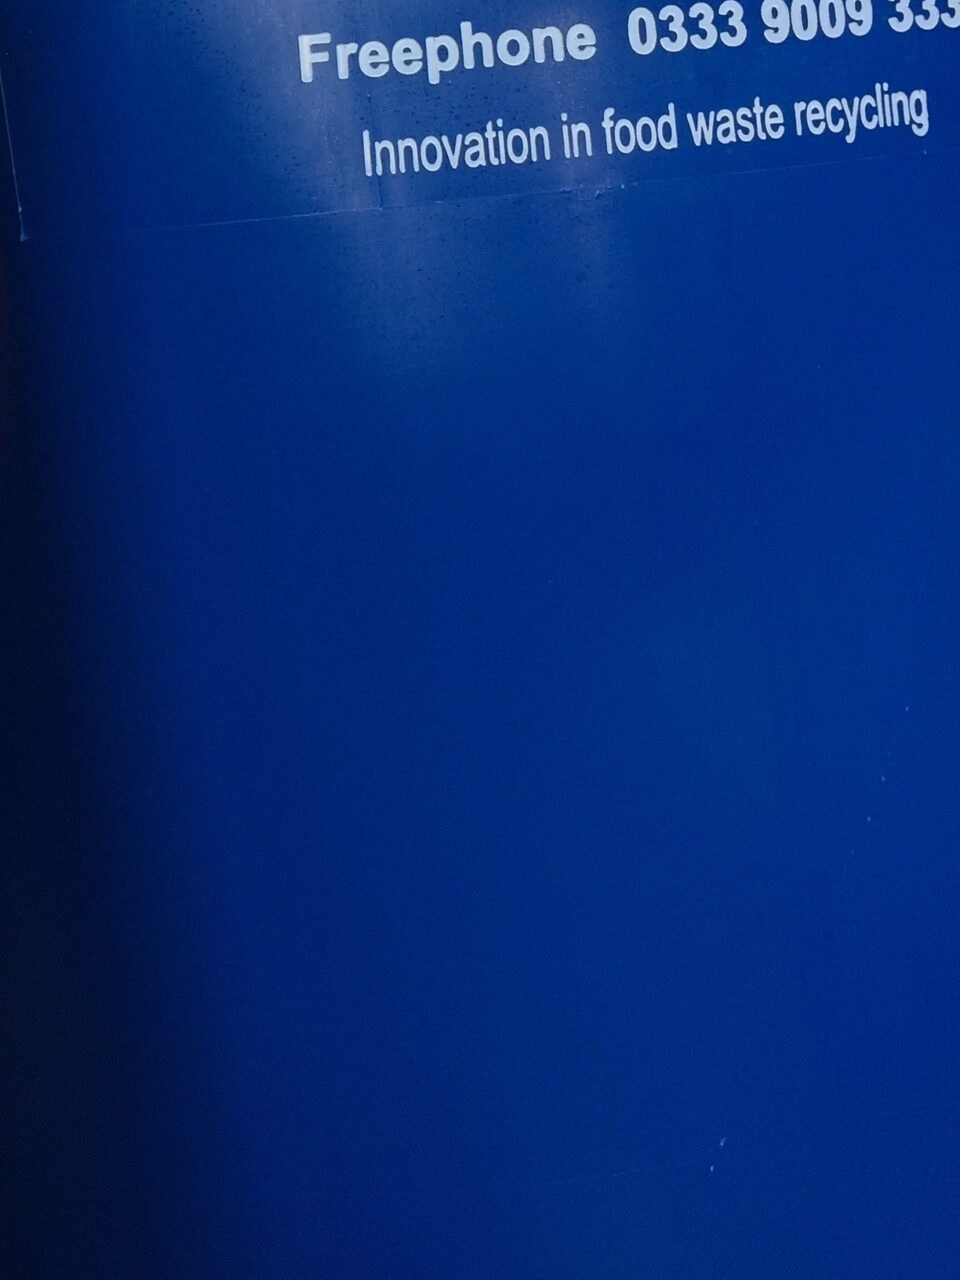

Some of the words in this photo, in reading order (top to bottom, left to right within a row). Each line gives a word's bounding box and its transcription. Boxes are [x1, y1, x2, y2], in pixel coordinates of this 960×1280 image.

[298, 21, 597, 84] Freephone
[626, 0, 748, 56] 0333
[362, 120, 552, 177] Innovation
[560, 113, 593, 159] in
[601, 102, 679, 153] food
[686, 97, 786, 147] waste
[793, 82, 930, 145] recycling
